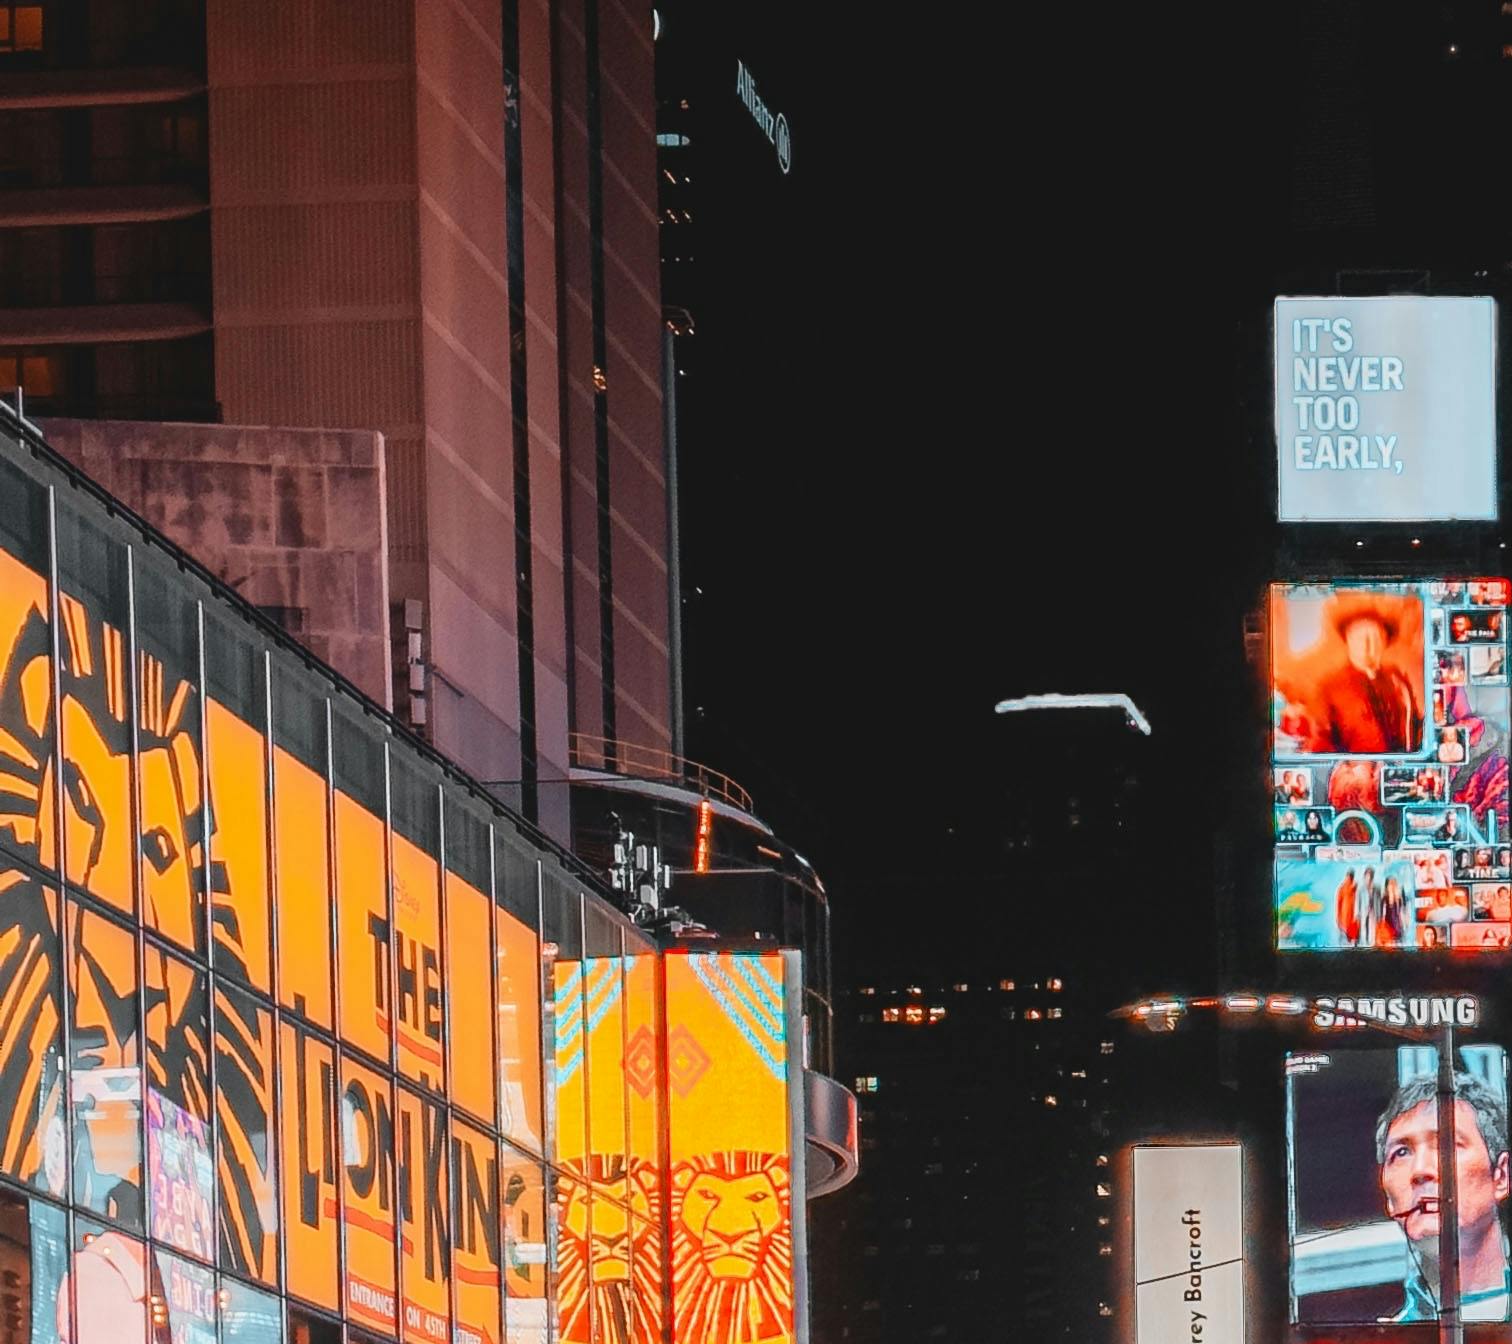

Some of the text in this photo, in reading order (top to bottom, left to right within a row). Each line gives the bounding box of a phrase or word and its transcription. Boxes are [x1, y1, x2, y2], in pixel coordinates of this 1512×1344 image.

[737, 59, 774, 144] Allianz
[1293, 317, 1353, 352] IT'S
[1294, 356, 1404, 391] NEVER
[1293, 396, 1360, 431] TOO
[1294, 435, 1405, 475] EARLY,
[368, 909, 441, 1043] THE
[1313, 996, 1478, 1027] SAMSUNG
[294, 991, 413, 1231] LION
[1181, 1208, 1203, 1302] Bancroft
[350, 1282, 395, 1319] ENTRANCE
[406, 1305, 421, 1329] ON
[425, 1313, 446, 1341] 45TH
